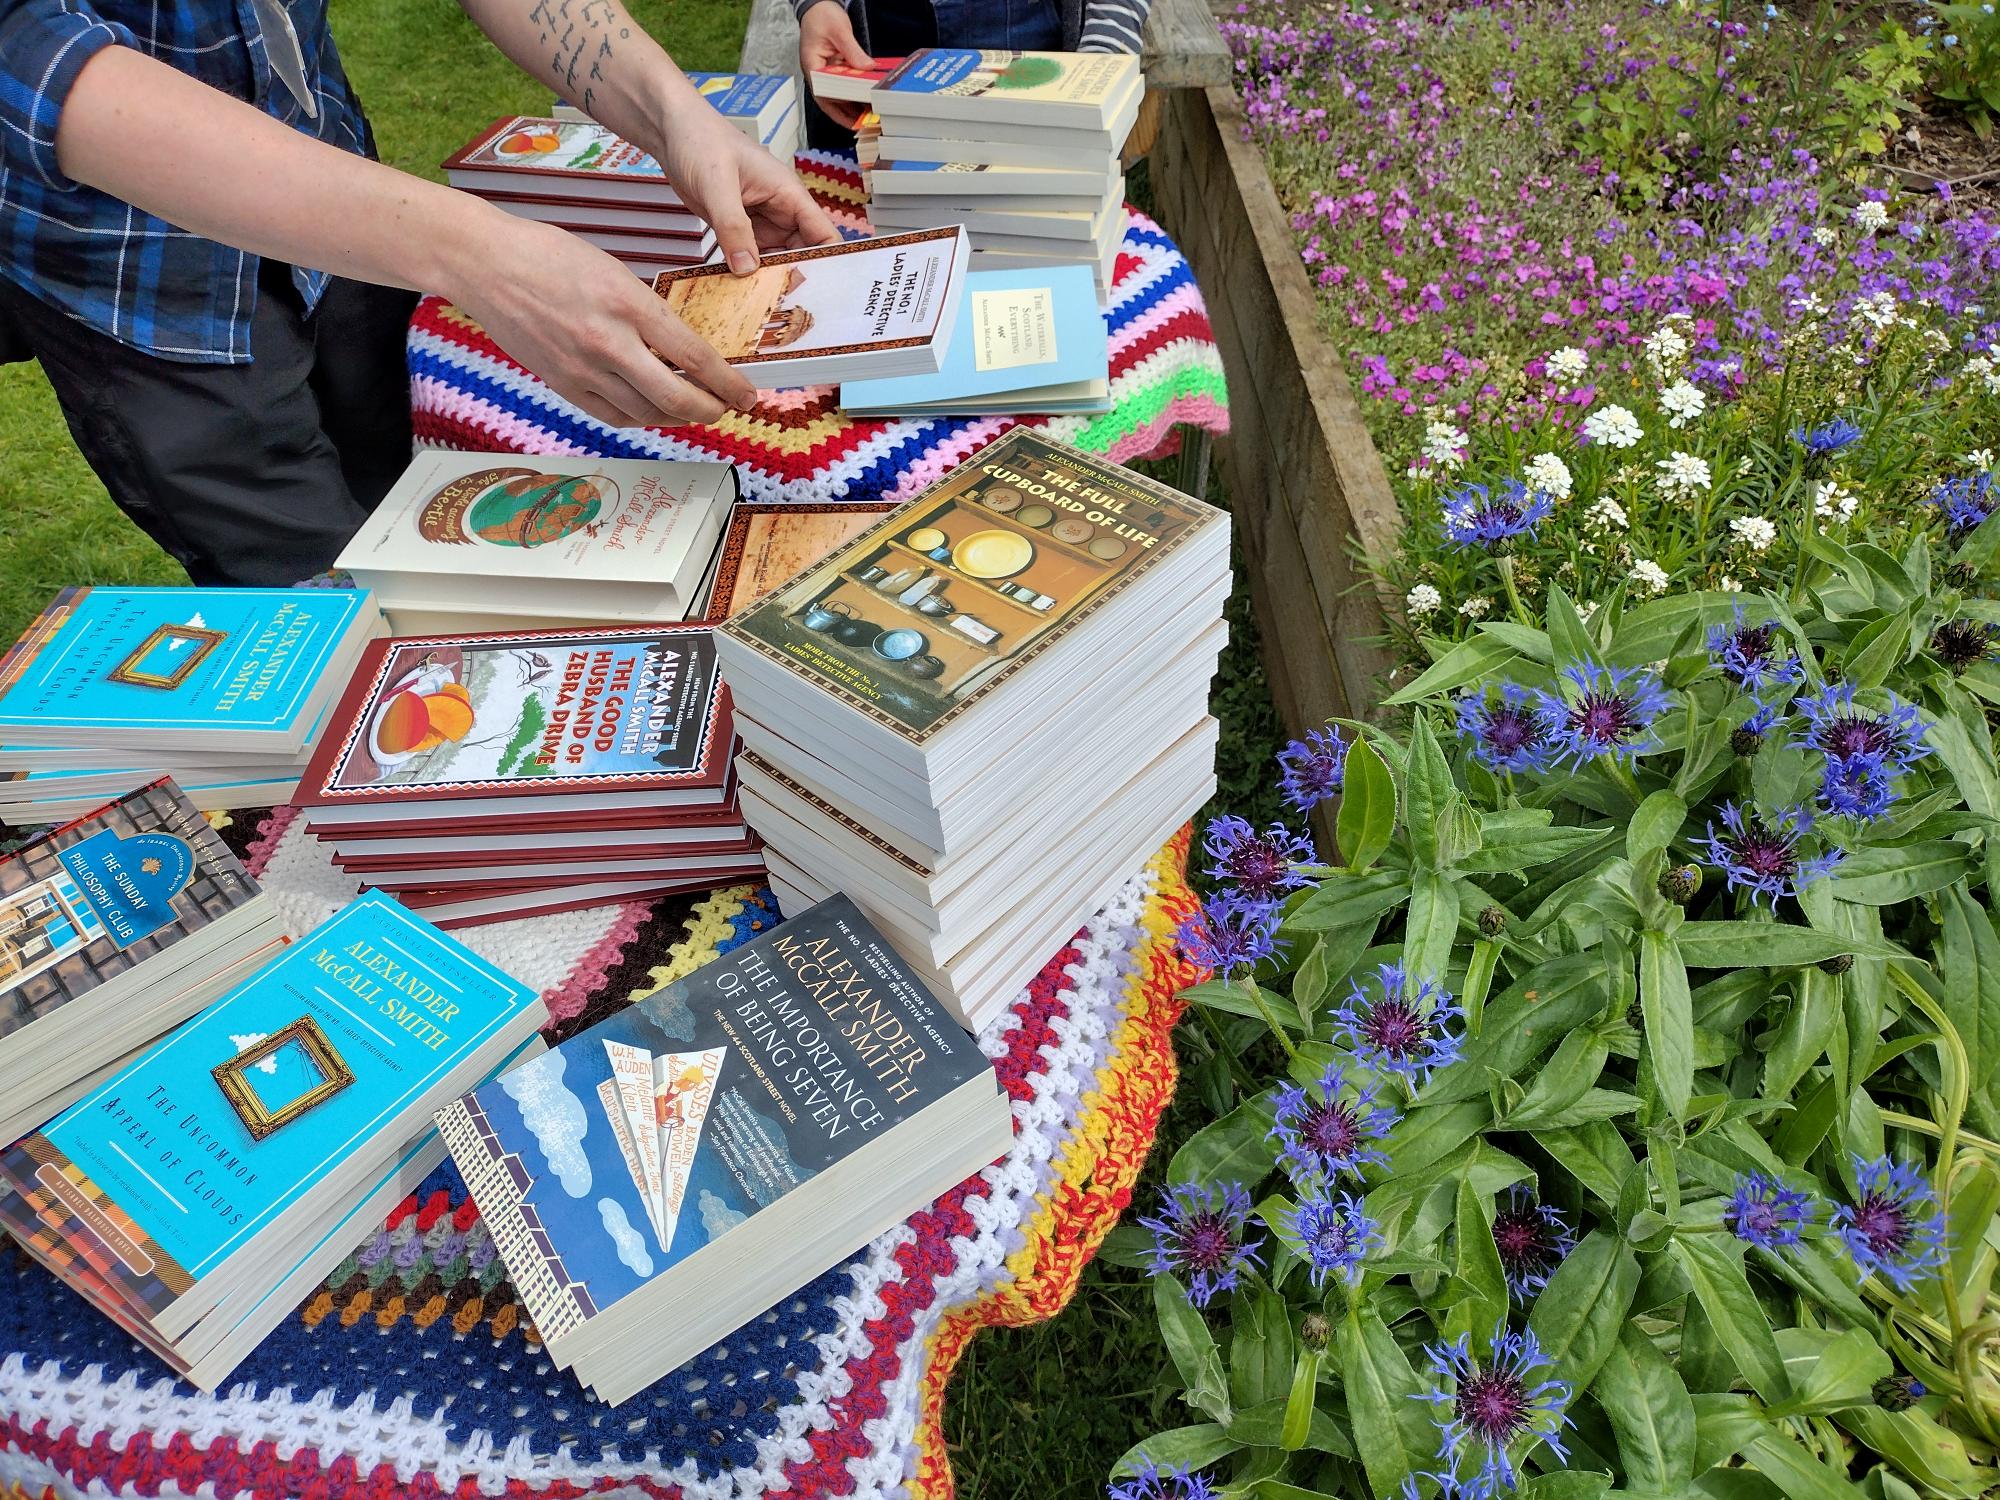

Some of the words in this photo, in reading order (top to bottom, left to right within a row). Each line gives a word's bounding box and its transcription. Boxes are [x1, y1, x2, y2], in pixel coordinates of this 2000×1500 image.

[889, 252, 907, 287] LADIES'
[905, 271, 918, 291] THE
[863, 280, 884, 316] AGENCY
[871, 289, 898, 337] DETECTIVE
[455, 487, 480, 507] World
[1036, 469, 1082, 492] THE
[1076, 487, 1131, 514] FULL
[1044, 452, 1097, 476] ALEXANDER
[1092, 473, 1132, 492] McCALL
[1126, 488, 1161, 505] SMITH
[424, 486, 463, 527] Bertie
[441, 507, 459, 540] according
[635, 486, 678, 545] Alexander
[978, 462, 1090, 515] CUPBOARD
[1081, 509, 1118, 528] OF
[1110, 523, 1161, 548] LIFE
[603, 512, 635, 551] Smith
[247, 603, 298, 656] McCALL
[65, 638, 124, 699] UNCOMMON
[72, 647, 90, 658] OF
[243, 611, 314, 701] ALEXANDER
[608, 657, 636, 691] THE
[690, 651, 698, 660] NO.
[800, 642, 826, 656] MORE
[822, 653, 847, 668] FROM
[842, 665, 863, 678] THE
[30, 668, 78, 712] CLOUDS
[213, 660, 260, 711] SMITH
[553, 650, 589, 706] ZEBRA
[568, 650, 614, 738] HUSBAND
[631, 651, 662, 703] McCALL
[678, 683, 690, 709] DETECTIVE
[689, 690, 698, 706] FROM
[810, 657, 854, 683] DETECTIVE
[850, 680, 884, 700] AGENCY
[591, 695, 625, 752] GOOD
[639, 649, 682, 754] ALEXANDER
[673, 710, 683, 731] AGENCY
[686, 707, 694, 719] THE
[533, 709, 571, 765] DRIVE
[563, 742, 586, 764] OF
[618, 706, 646, 755] SMITH
[163, 801, 198, 837] NATIONAL
[191, 836, 237, 886] BESTSELLER
[64, 851, 117, 910] PHILOSOPHY
[104, 908, 137, 940] CLUB
[98, 852, 122, 873] THE
[111, 870, 150, 911] SUNDAY
[306, 946, 389, 1006] McCALL
[375, 995, 452, 1052] SMITH
[341, 937, 464, 1025] ALEXANDER
[424, 951, 499, 1002] BESTSELLER
[834, 919, 850, 935] THE
[846, 933, 862, 948] NO.
[863, 953, 891, 982] LADIES'
[887, 981, 925, 1023] DETECTIVE
[921, 1022, 954, 1056] AGENCY
[867, 942, 903, 980] BESTSELLING
[900, 979, 925, 1006] AUTHOR
[922, 1006, 935, 1017] OF
[770, 932, 854, 1022] McCALL
[838, 1017, 920, 1105] SMITH
[802, 931, 934, 1076] ALEXANDER
[320, 1010, 334, 1021] THE
[358, 1038, 386, 1060] DETECTIVE
[381, 1056, 405, 1074] AGENCY
[712, 969, 748, 1002] OF
[733, 998, 798, 1069] BEING
[782, 1064, 852, 1141] SEVEN
[733, 948, 779, 992] THE
[765, 989, 886, 1132] IMPORTANCE
[615, 1059, 651, 1074] AUDEN
[688, 1052, 719, 1122] ULYSSES
[711, 1008, 726, 1022] THE
[719, 1020, 736, 1037] NEW
[730, 1035, 743, 1046] 44
[737, 1044, 766, 1079] SCOTLAND
[760, 1076, 783, 1102] STREET
[776, 1099, 799, 1124] NOVEL
[619, 1082, 638, 1113] Klein
[636, 1077, 655, 1122] Melanie
[718, 1090, 737, 1113] humans
[727, 1085, 747, 1107] "McCall
[732, 1112, 742, 1122] are
[741, 1105, 760, 1126] Smith's
[143, 1084, 182, 1117] THE
[178, 1113, 262, 1188] UNCOMMON
[600, 1082, 619, 1121] Bears
[613, 1120, 634, 1155] LITTLE
[628, 1157, 648, 1191] HANS
[638, 1123, 655, 1166] Subjective
[670, 1127, 685, 1172] POWELL
[681, 1125, 698, 1166] BADEN
[711, 1116, 724, 1132] vivid
[719, 1129, 731, 1142] and
[721, 1115, 746, 1145] depictions
[736, 1119, 757, 1143] piercing
[741, 1142, 751, 1152] of
[752, 1139, 764, 1152] and
[753, 1124, 782, 1159] assessments
[100, 1095, 162, 1150] APPEAL
[157, 1148, 183, 1171] OF
[181, 1166, 249, 1227] CLOUDS
[716, 1145, 739, 1173] Francisco
[733, 1170, 757, 1200] Chronicle
[743, 1149, 769, 1180] Edinburgh
[763, 1177, 774, 1188] are
[776, 1156, 786, 1166] of
[780, 1163, 799, 1185] fellow
[667, 1172, 684, 1215] Siblings
[62, 1186, 87, 1210] ISABEL
[112, 1234, 135, 1257] NOVEL
